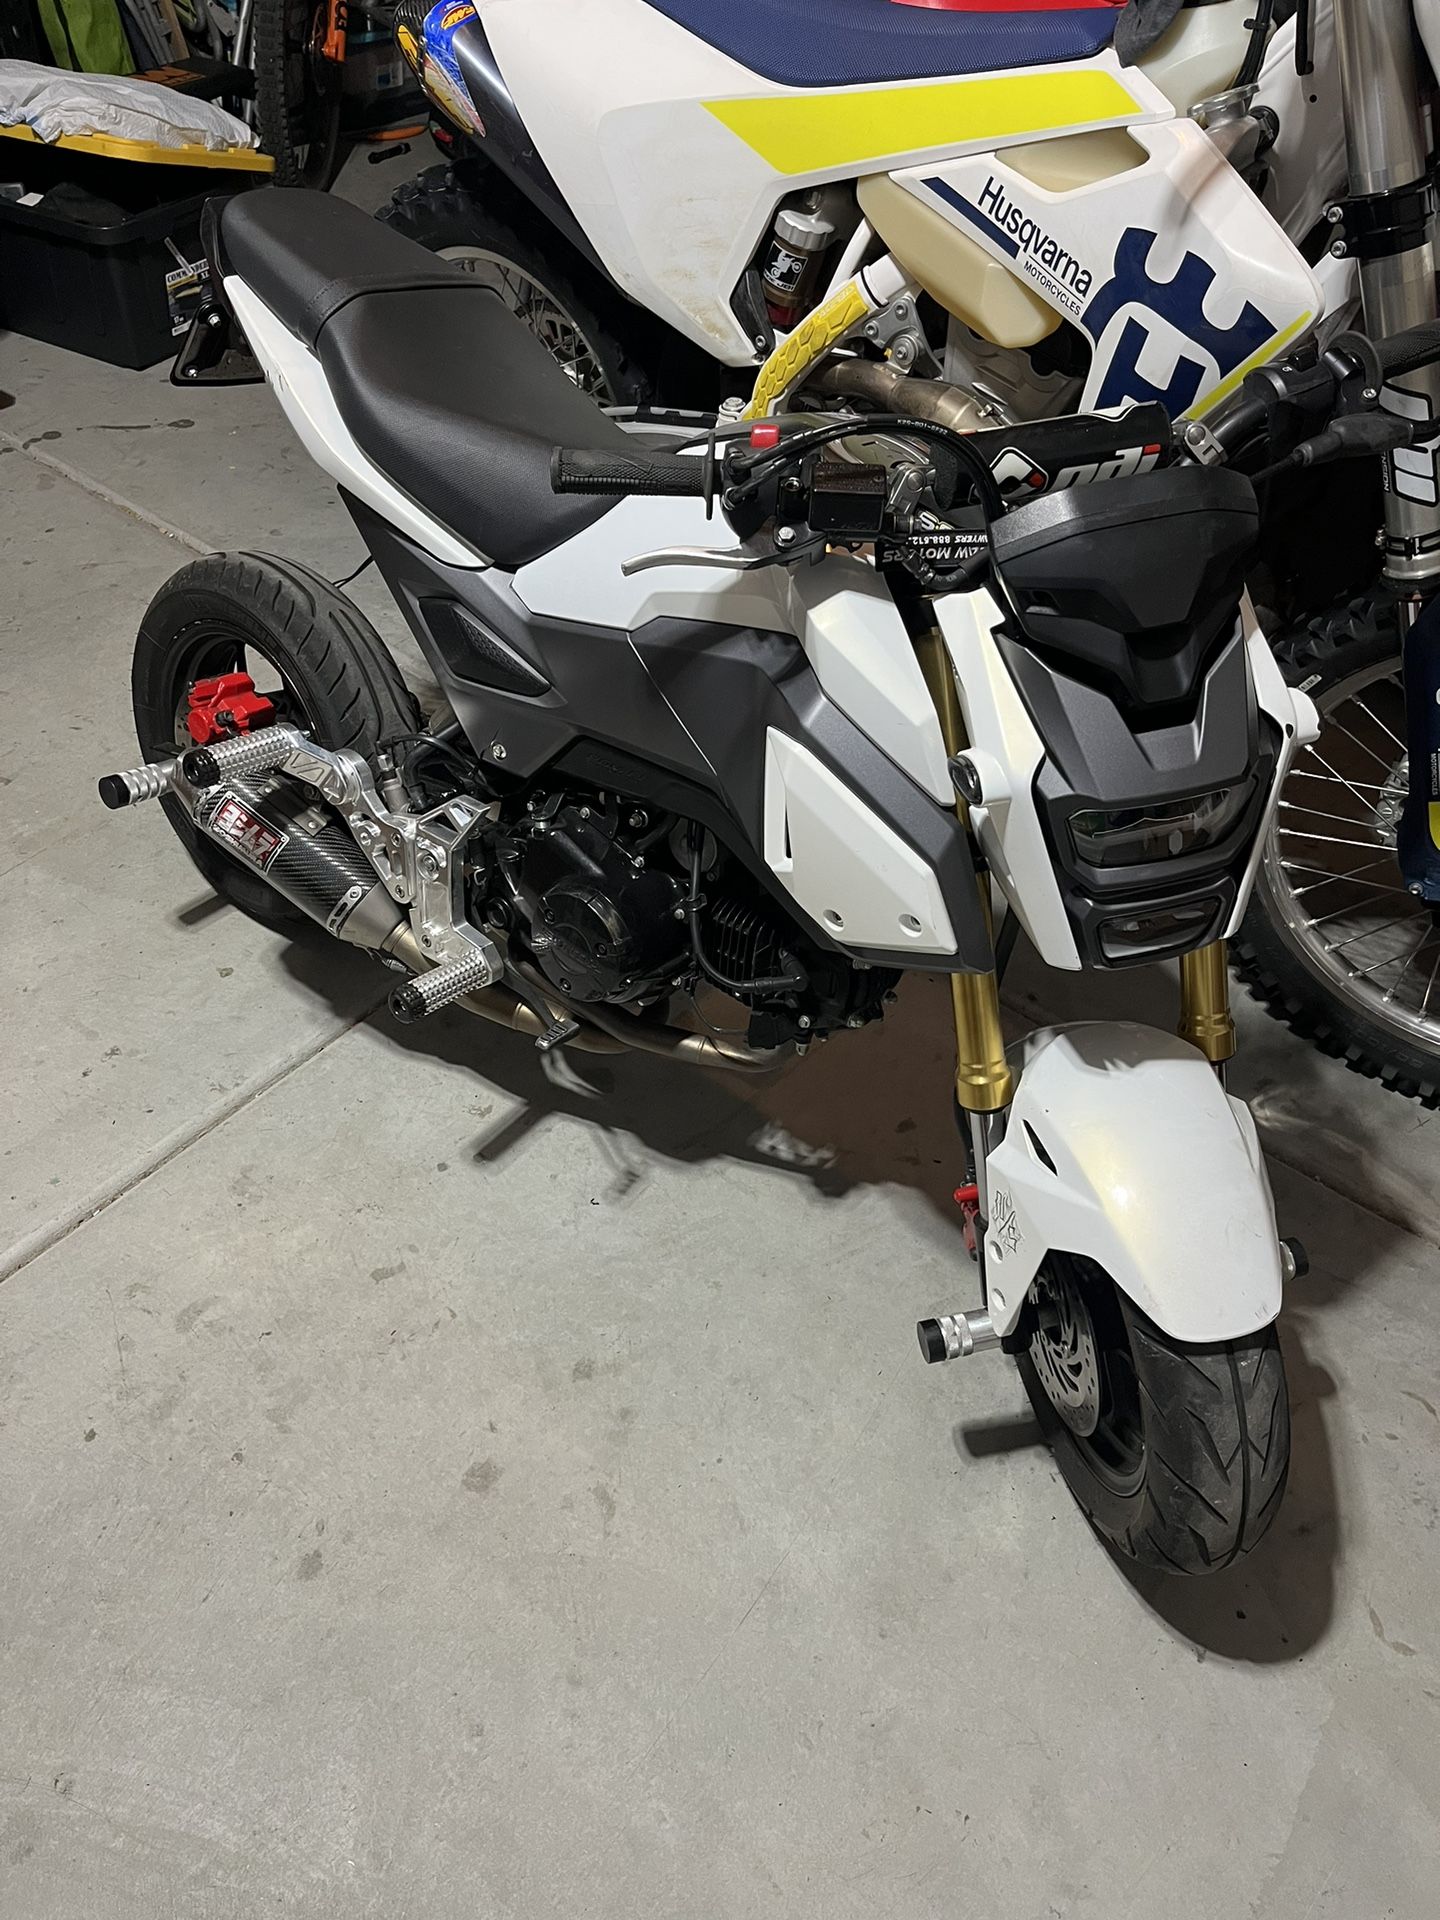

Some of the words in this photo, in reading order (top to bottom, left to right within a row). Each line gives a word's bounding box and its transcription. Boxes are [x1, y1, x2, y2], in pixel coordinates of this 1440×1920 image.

[977, 176, 1093, 298] Husqvarna
[167, 260, 209, 283] COMMNDER
[1023, 260, 1081, 316] MOTORCYCLES
[1430, 753, 1438, 796] MOTORCYCLES
